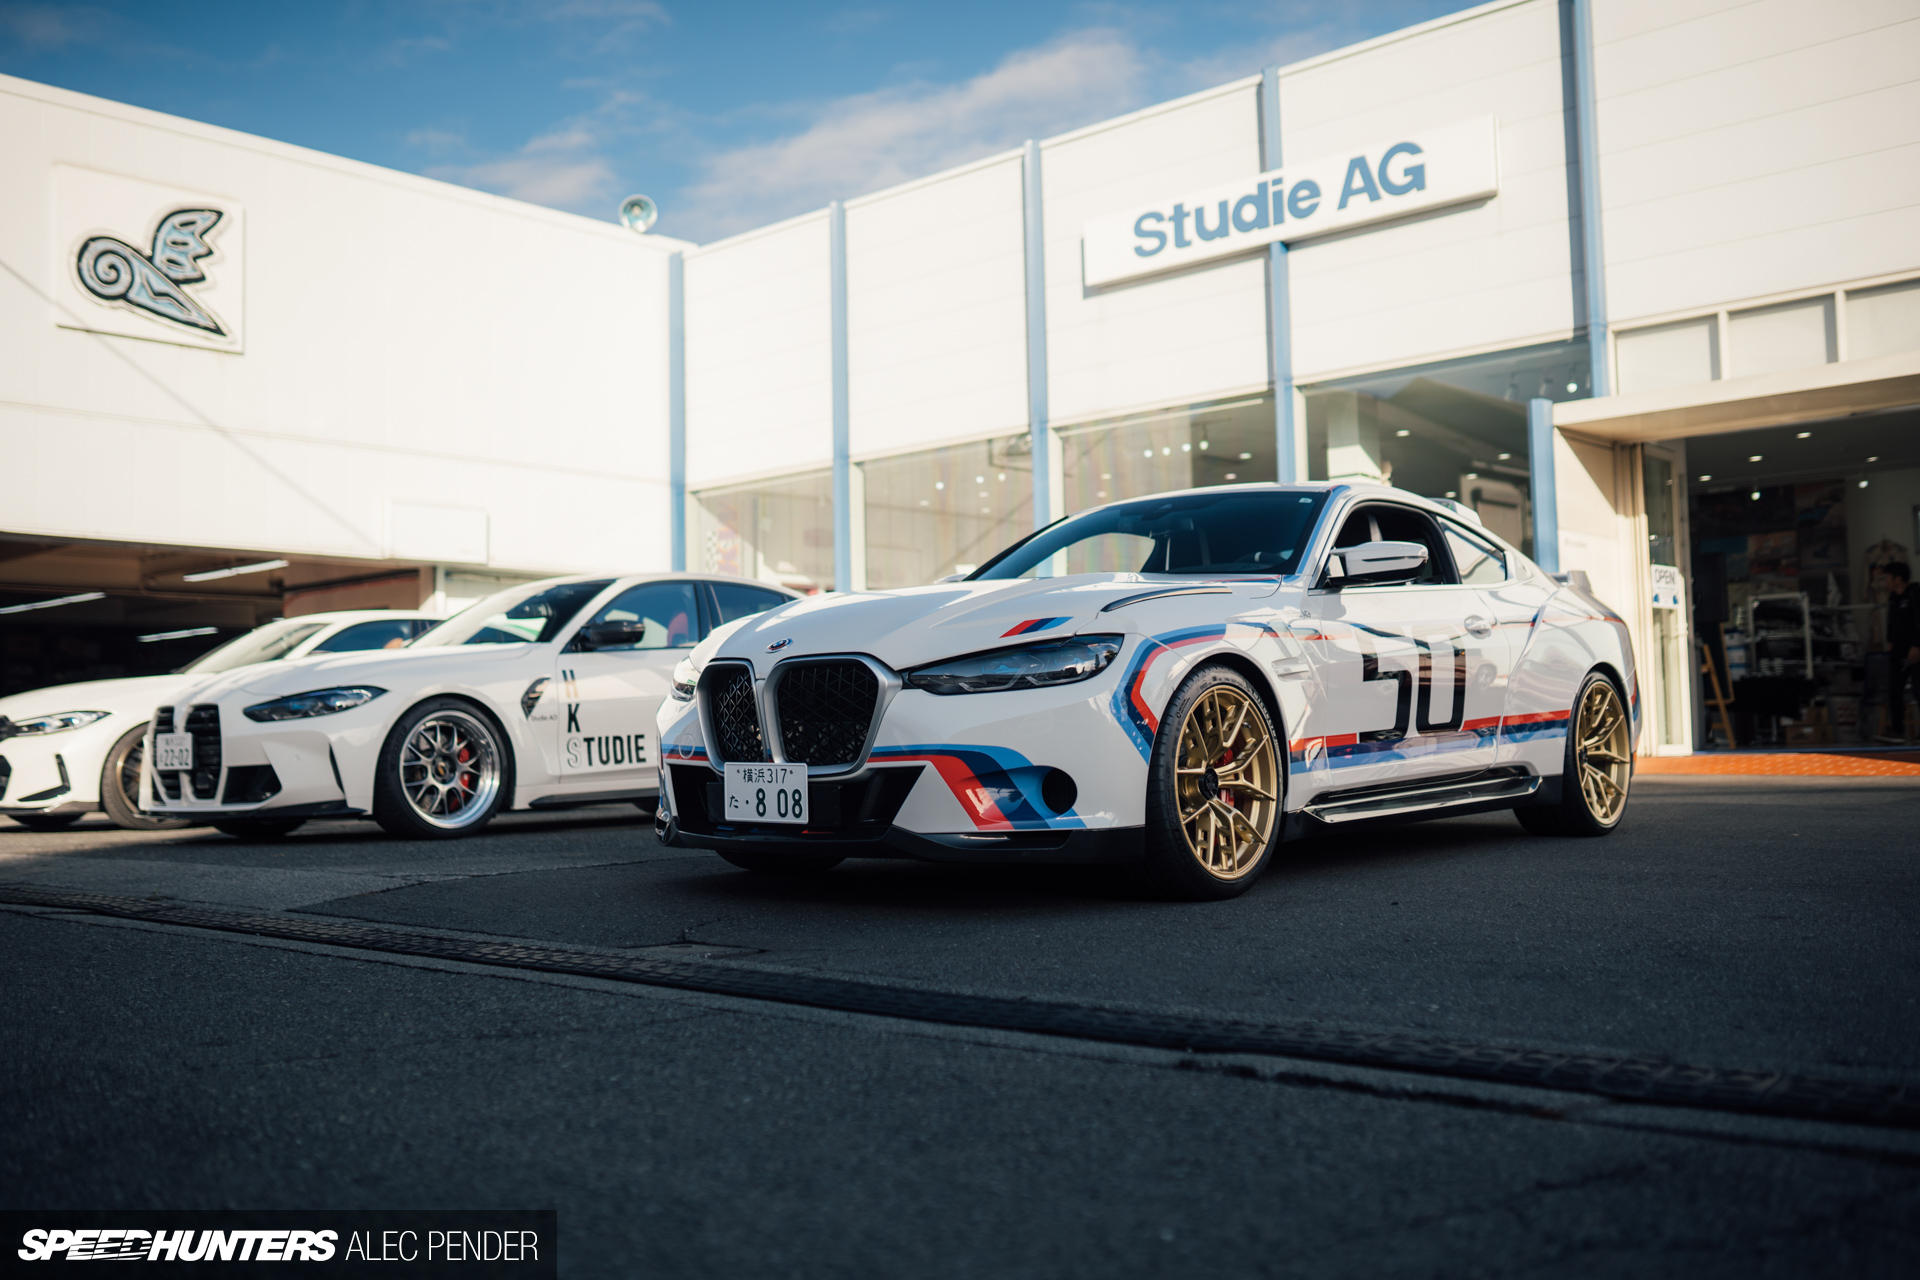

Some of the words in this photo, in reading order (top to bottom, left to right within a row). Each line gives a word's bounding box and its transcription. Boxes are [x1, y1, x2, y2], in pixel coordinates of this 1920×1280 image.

[1133, 177, 1321, 257] Studie
[1337, 141, 1426, 211] AG
[1654, 568, 1676, 585] OPEN
